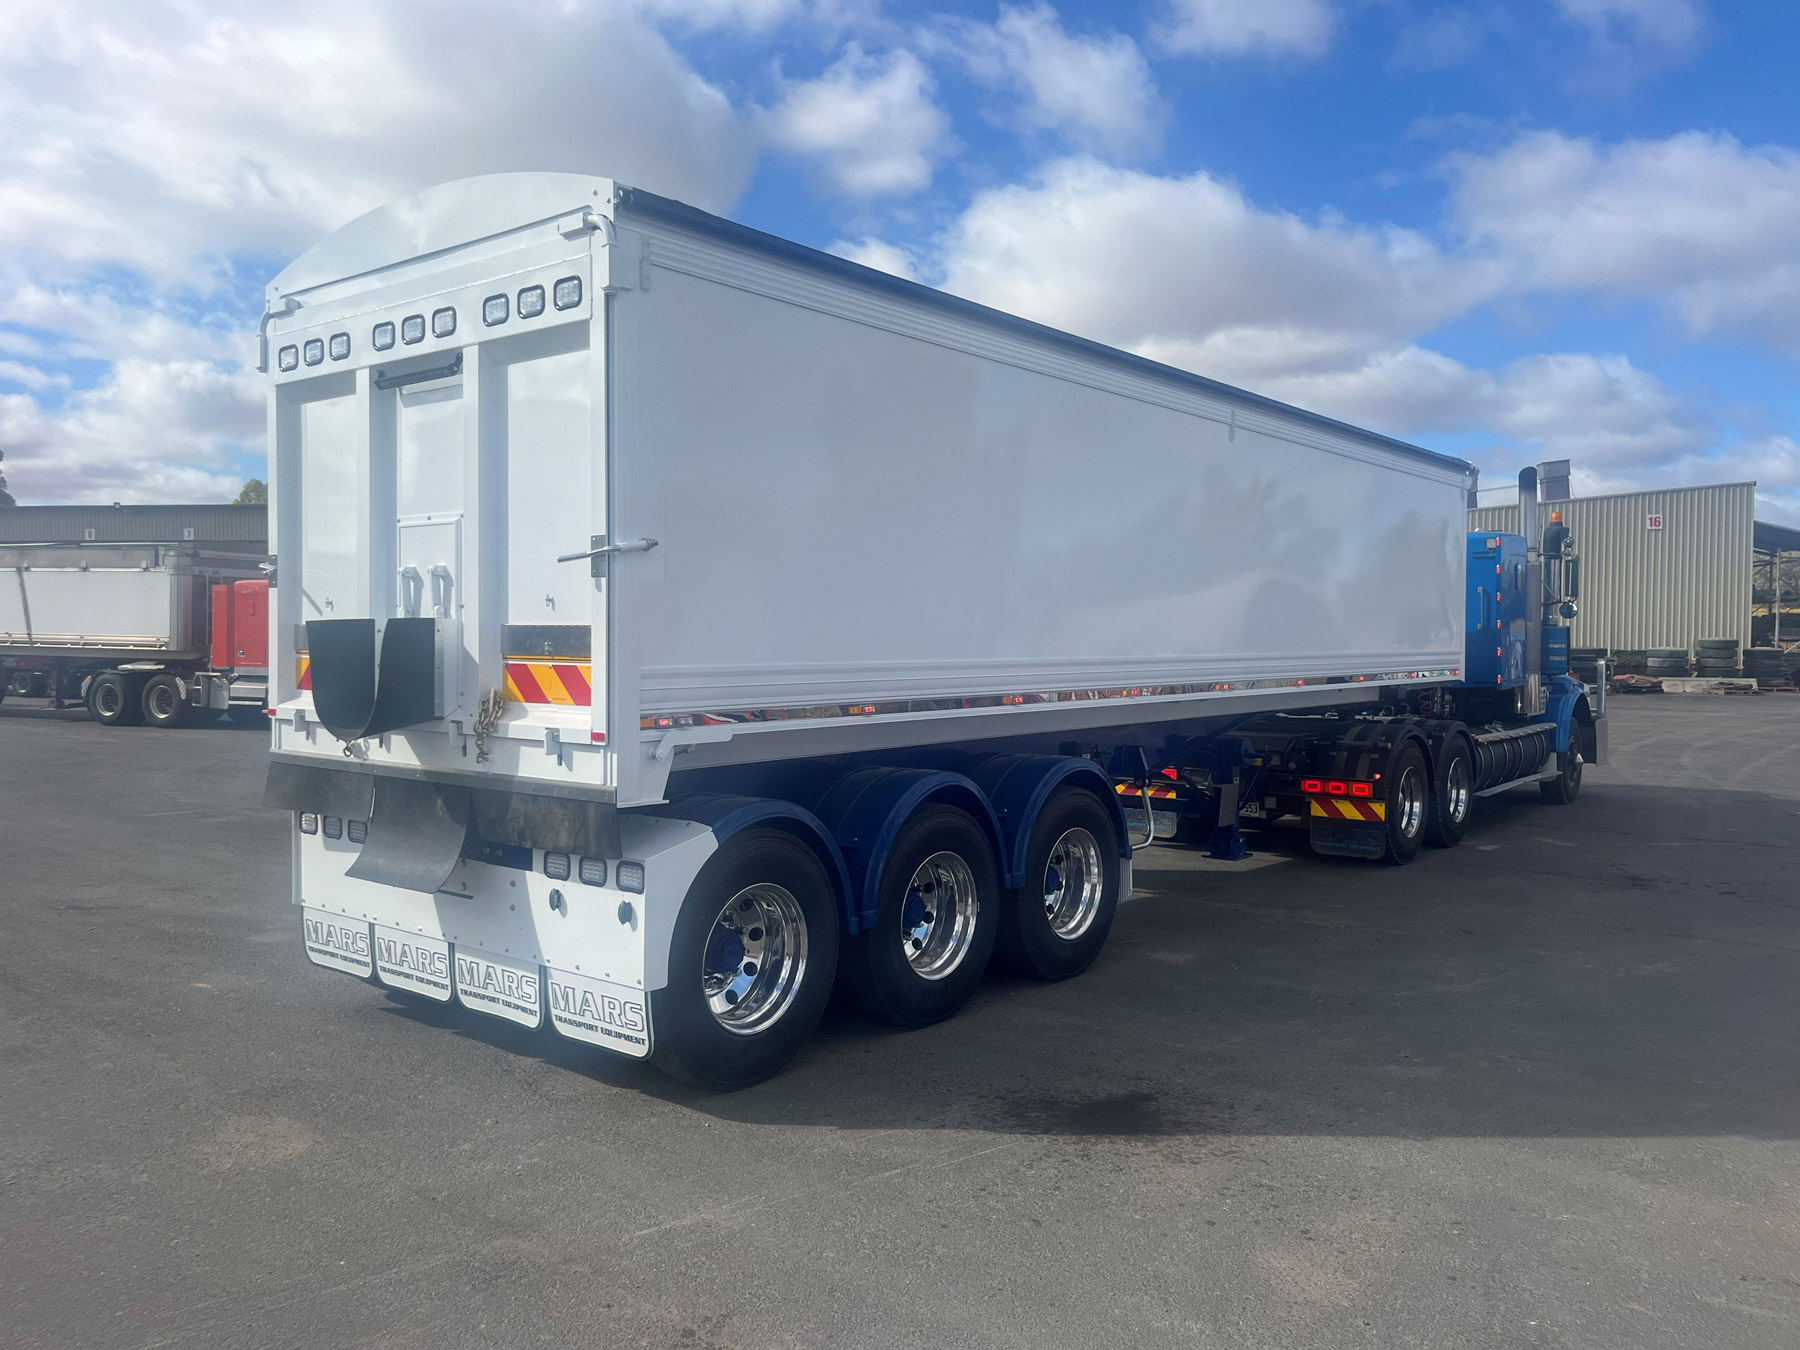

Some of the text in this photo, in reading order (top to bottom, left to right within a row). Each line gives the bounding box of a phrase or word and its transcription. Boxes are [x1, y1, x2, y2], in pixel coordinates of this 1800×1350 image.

[88, 530, 93, 539] 6
[187, 530, 191, 538] 7
[1648, 516, 1661, 527] 16
[305, 919, 369, 957] MARS
[308, 946, 370, 968] TRANSPORT EQUIPMENT
[377, 937, 448, 979] MARS
[379, 965, 449, 991] TRANSPORT EQUIPMENT
[458, 958, 537, 1004] MARS
[460, 988, 538, 1017] TRANSPORT EQUIPMENT
[550, 982, 644, 1032] MARS
[554, 1014, 646, 1045] TRANSPORT EQUIPMENT
